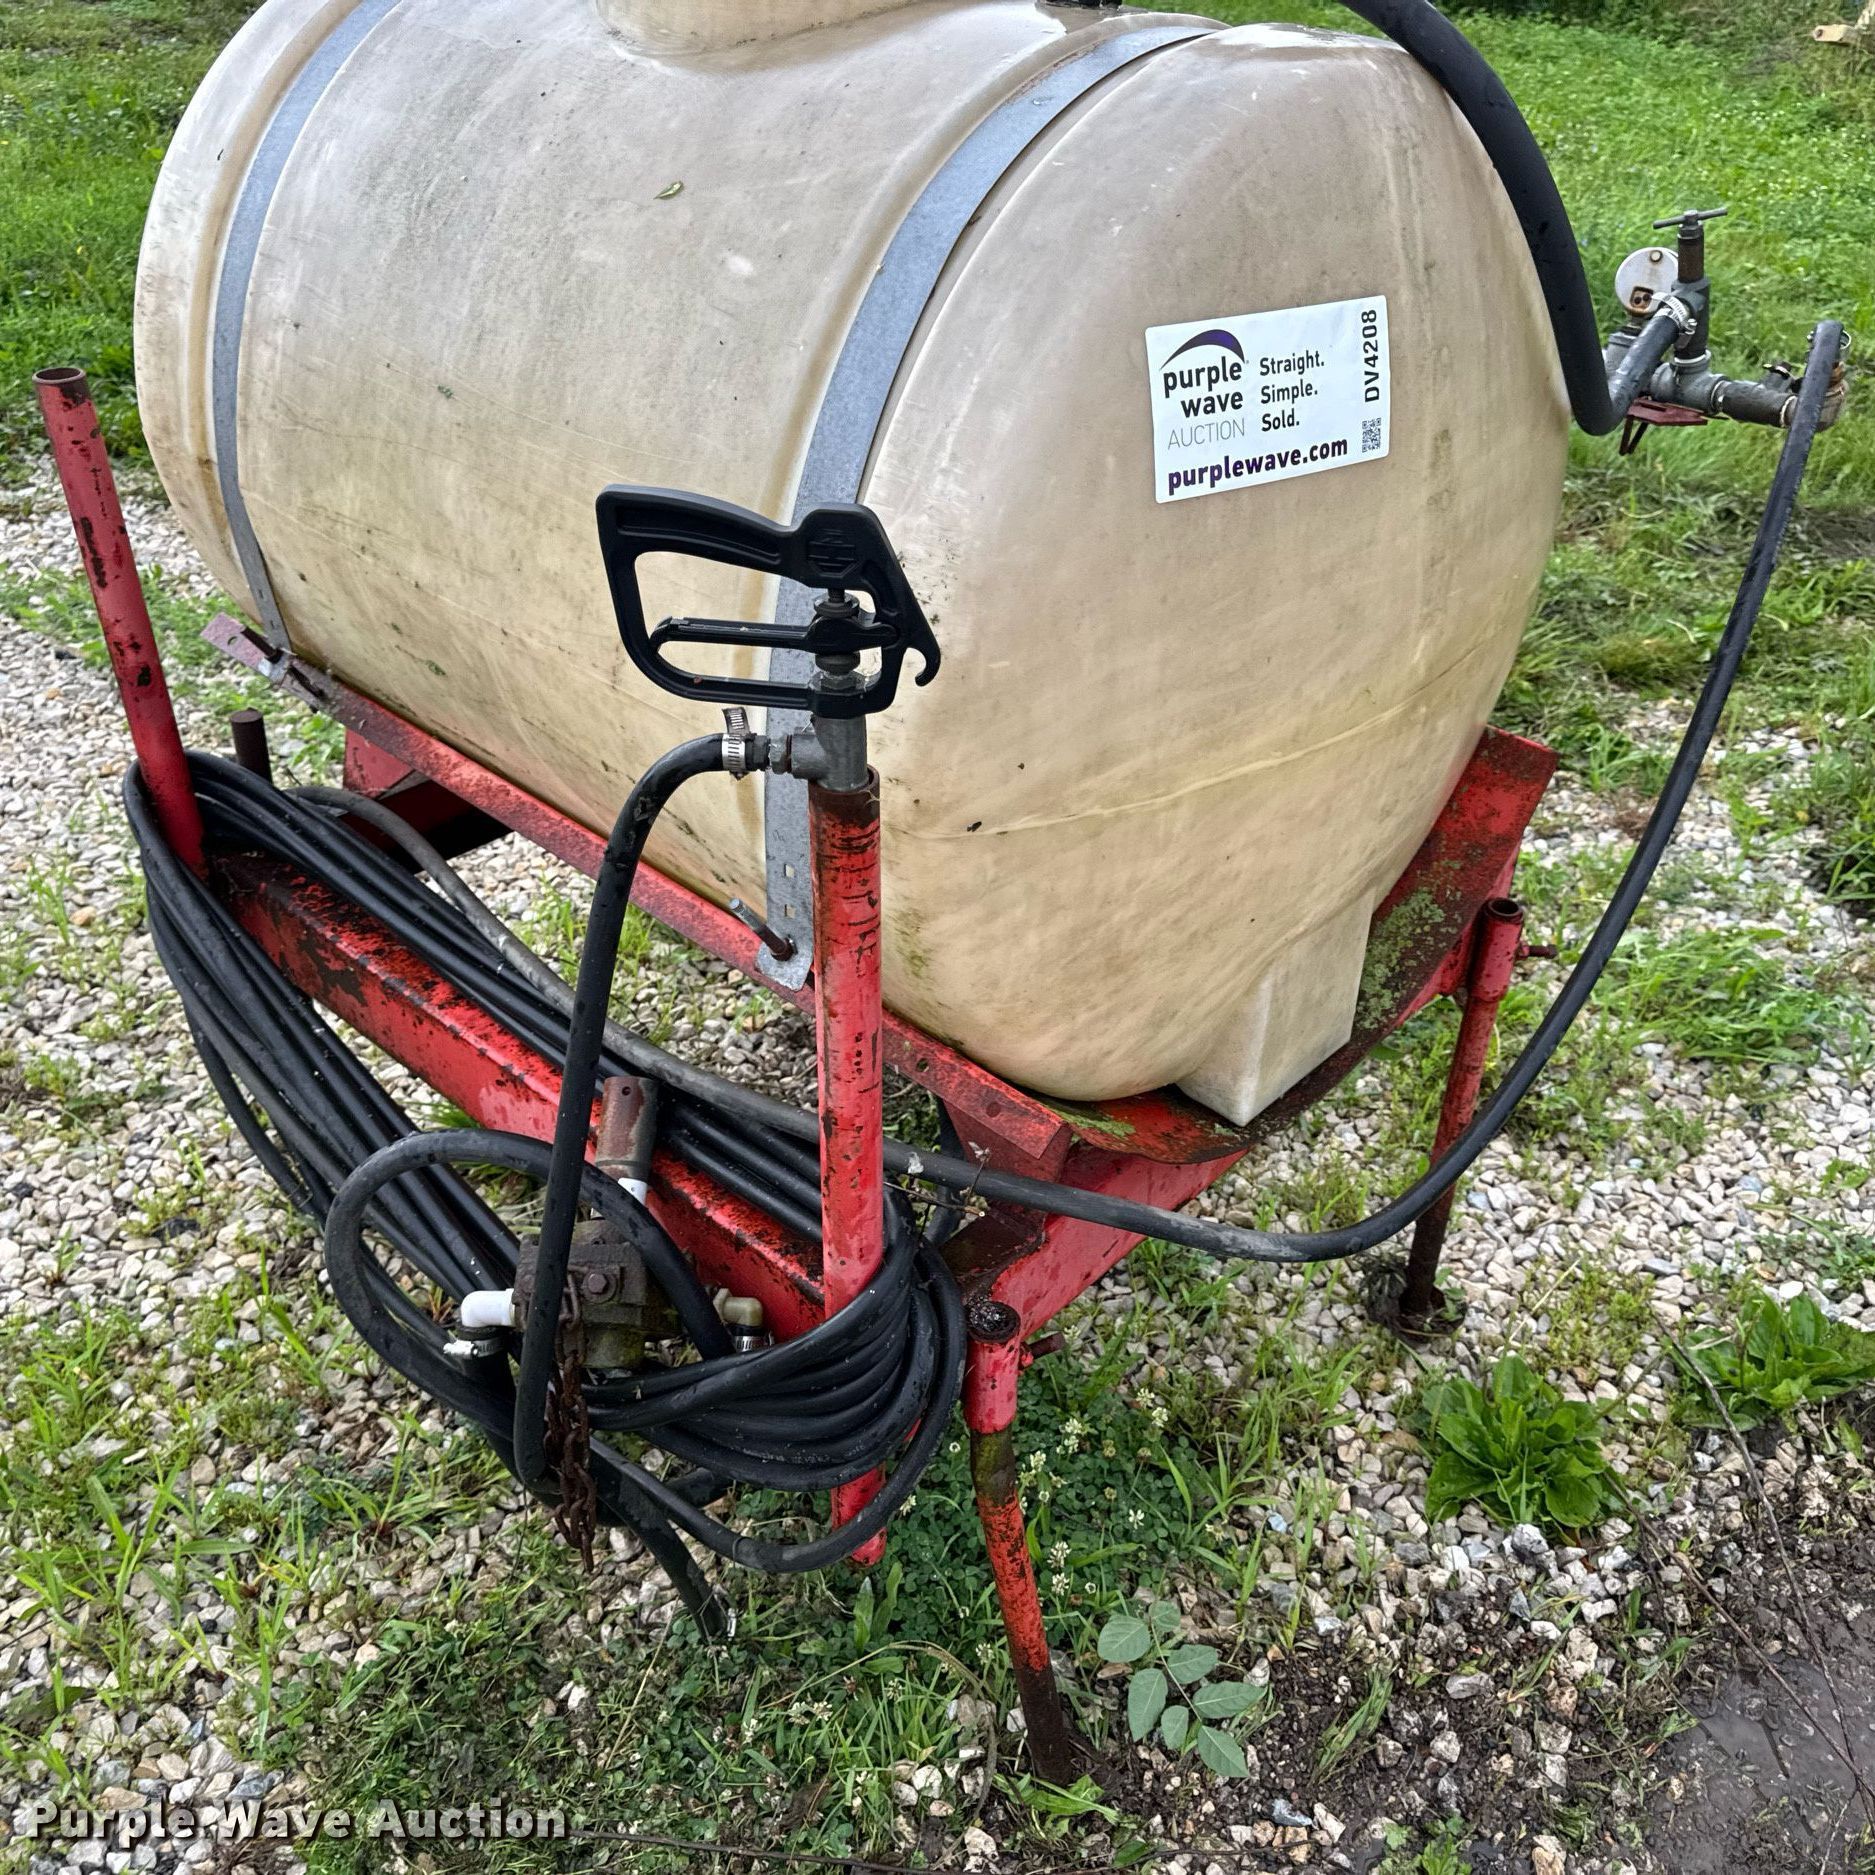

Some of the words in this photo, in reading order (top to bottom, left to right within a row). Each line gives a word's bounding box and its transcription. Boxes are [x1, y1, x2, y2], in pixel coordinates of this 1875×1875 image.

[1259, 350, 1325, 376] Straight.
[1361, 309, 1380, 403] DV4208
[1163, 356, 1243, 398] purple
[1260, 379, 1318, 404] Simple.
[1181, 391, 1243, 418] wave
[1167, 418, 1245, 450] AUCTION
[1261, 408, 1300, 432] Sold.
[1168, 439, 1348, 495] purplewave.com
